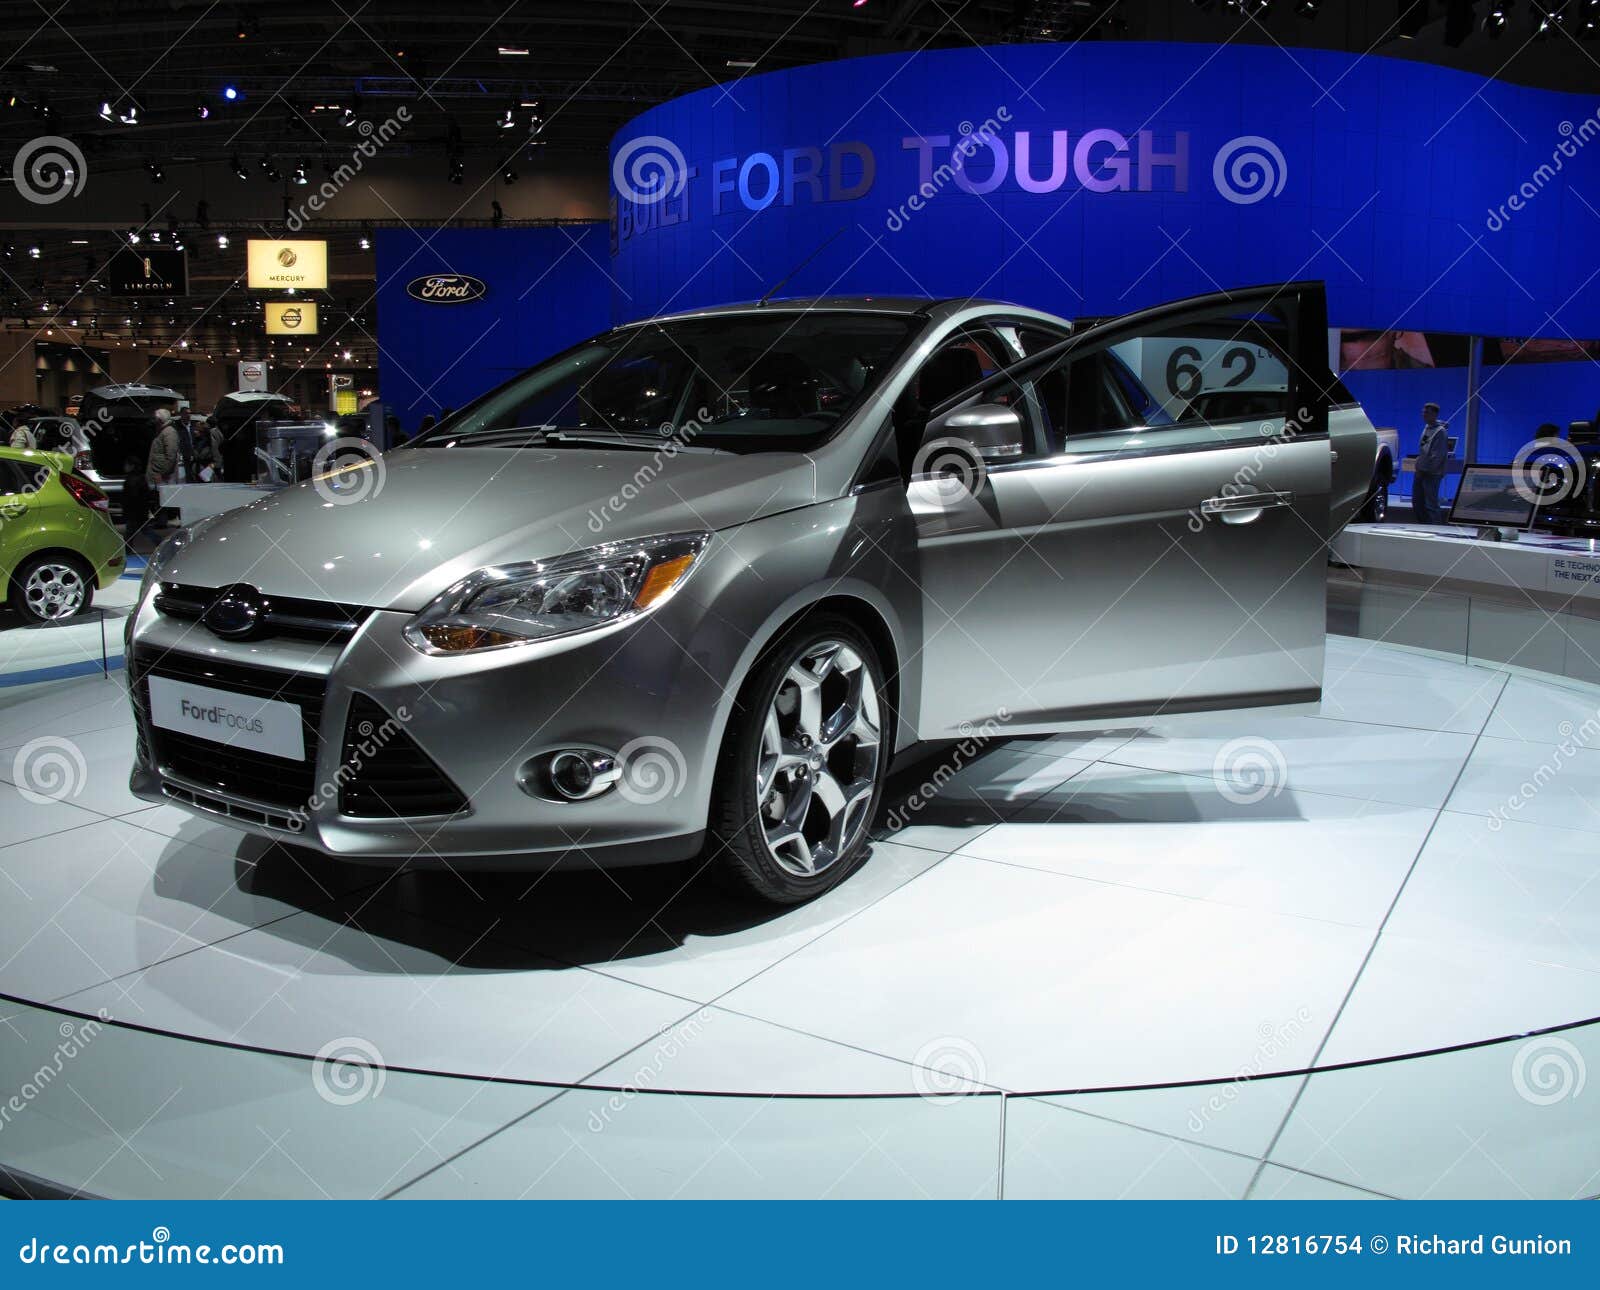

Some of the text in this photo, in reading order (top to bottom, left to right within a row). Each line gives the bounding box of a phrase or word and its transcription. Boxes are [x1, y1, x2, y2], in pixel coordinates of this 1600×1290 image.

[617, 128, 1190, 240] BUILT FORD TOUGH
[422, 277, 469, 297] Ford
[1554, 559, 1566, 568] BE
[1554, 569, 1570, 580] THE
[1571, 572, 1592, 582] NEXT
